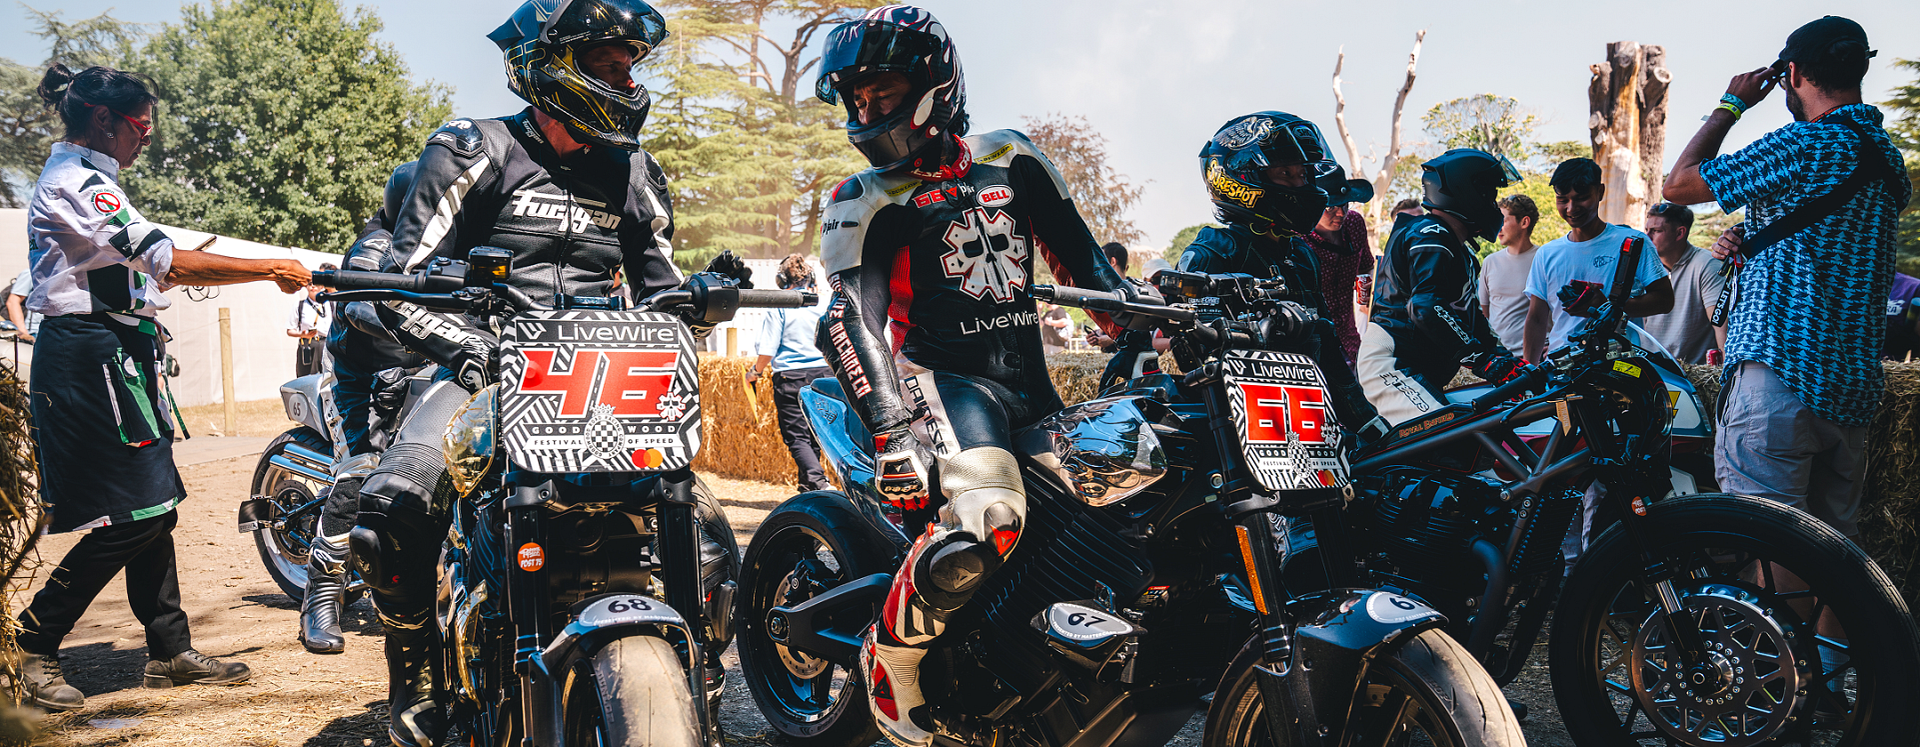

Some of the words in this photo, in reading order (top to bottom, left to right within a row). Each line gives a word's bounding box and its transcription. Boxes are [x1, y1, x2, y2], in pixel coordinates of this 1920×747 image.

[981, 189, 1010, 203] BELL
[960, 310, 1039, 335] LiveWire
[557, 323, 675, 341] LiveWire
[1251, 362, 1316, 380] LiveWire
[517, 348, 681, 418] 46
[293, 402, 301, 417] 65
[1237, 382, 1325, 444] 66
[531, 426, 581, 435] GOOD
[627, 425, 676, 434] WOOD
[1398, 423, 1423, 438] ROYAL
[520, 559, 535, 568] POST
[608, 598, 652, 614] 68
[1068, 612, 1107, 628] 67
